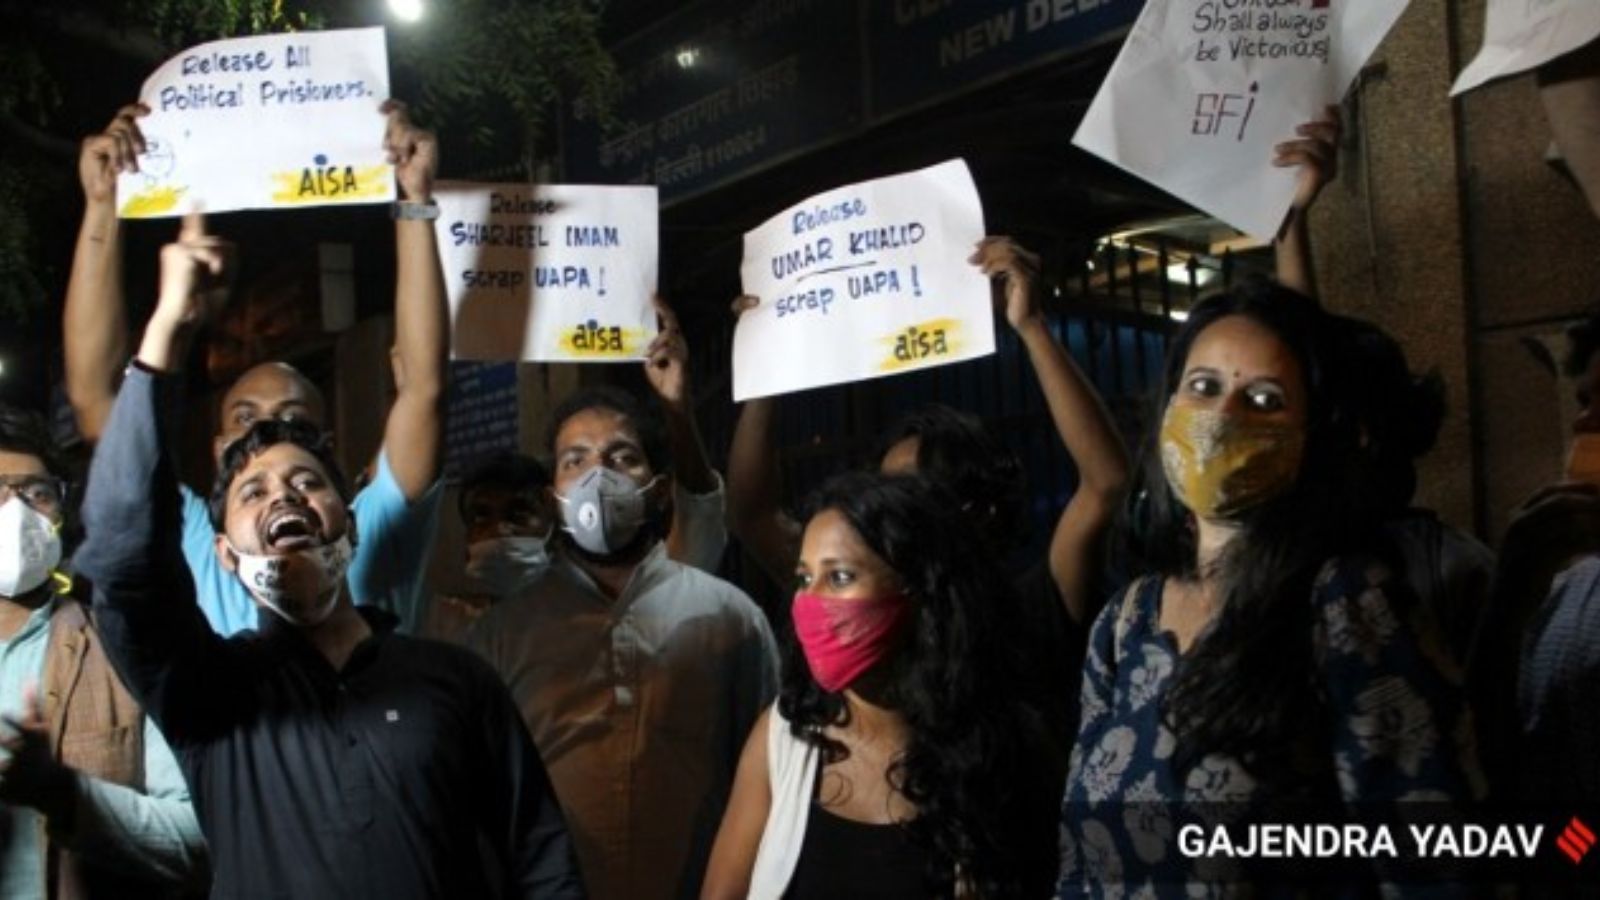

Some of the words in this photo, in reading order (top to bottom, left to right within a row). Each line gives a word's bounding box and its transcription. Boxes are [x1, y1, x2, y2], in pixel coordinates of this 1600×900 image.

[1192, 2, 1252, 32] Shall
[1256, 11, 1328, 38] always
[939, 9, 1016, 67] NEW
[1195, 40, 1220, 61] be
[181, 49, 272, 75] Release
[160, 82, 243, 111] Political
[489, 193, 557, 215] Release
[791, 198, 867, 235] Release
[450, 220, 549, 247] SHARJEEL
[566, 225, 619, 247] IMAM
[771, 238, 833, 280] UMAR
[849, 222, 925, 255] KHALID
[462, 269, 524, 294] scrap
[776, 288, 835, 315] scrap
[894, 327, 948, 361] aisa
